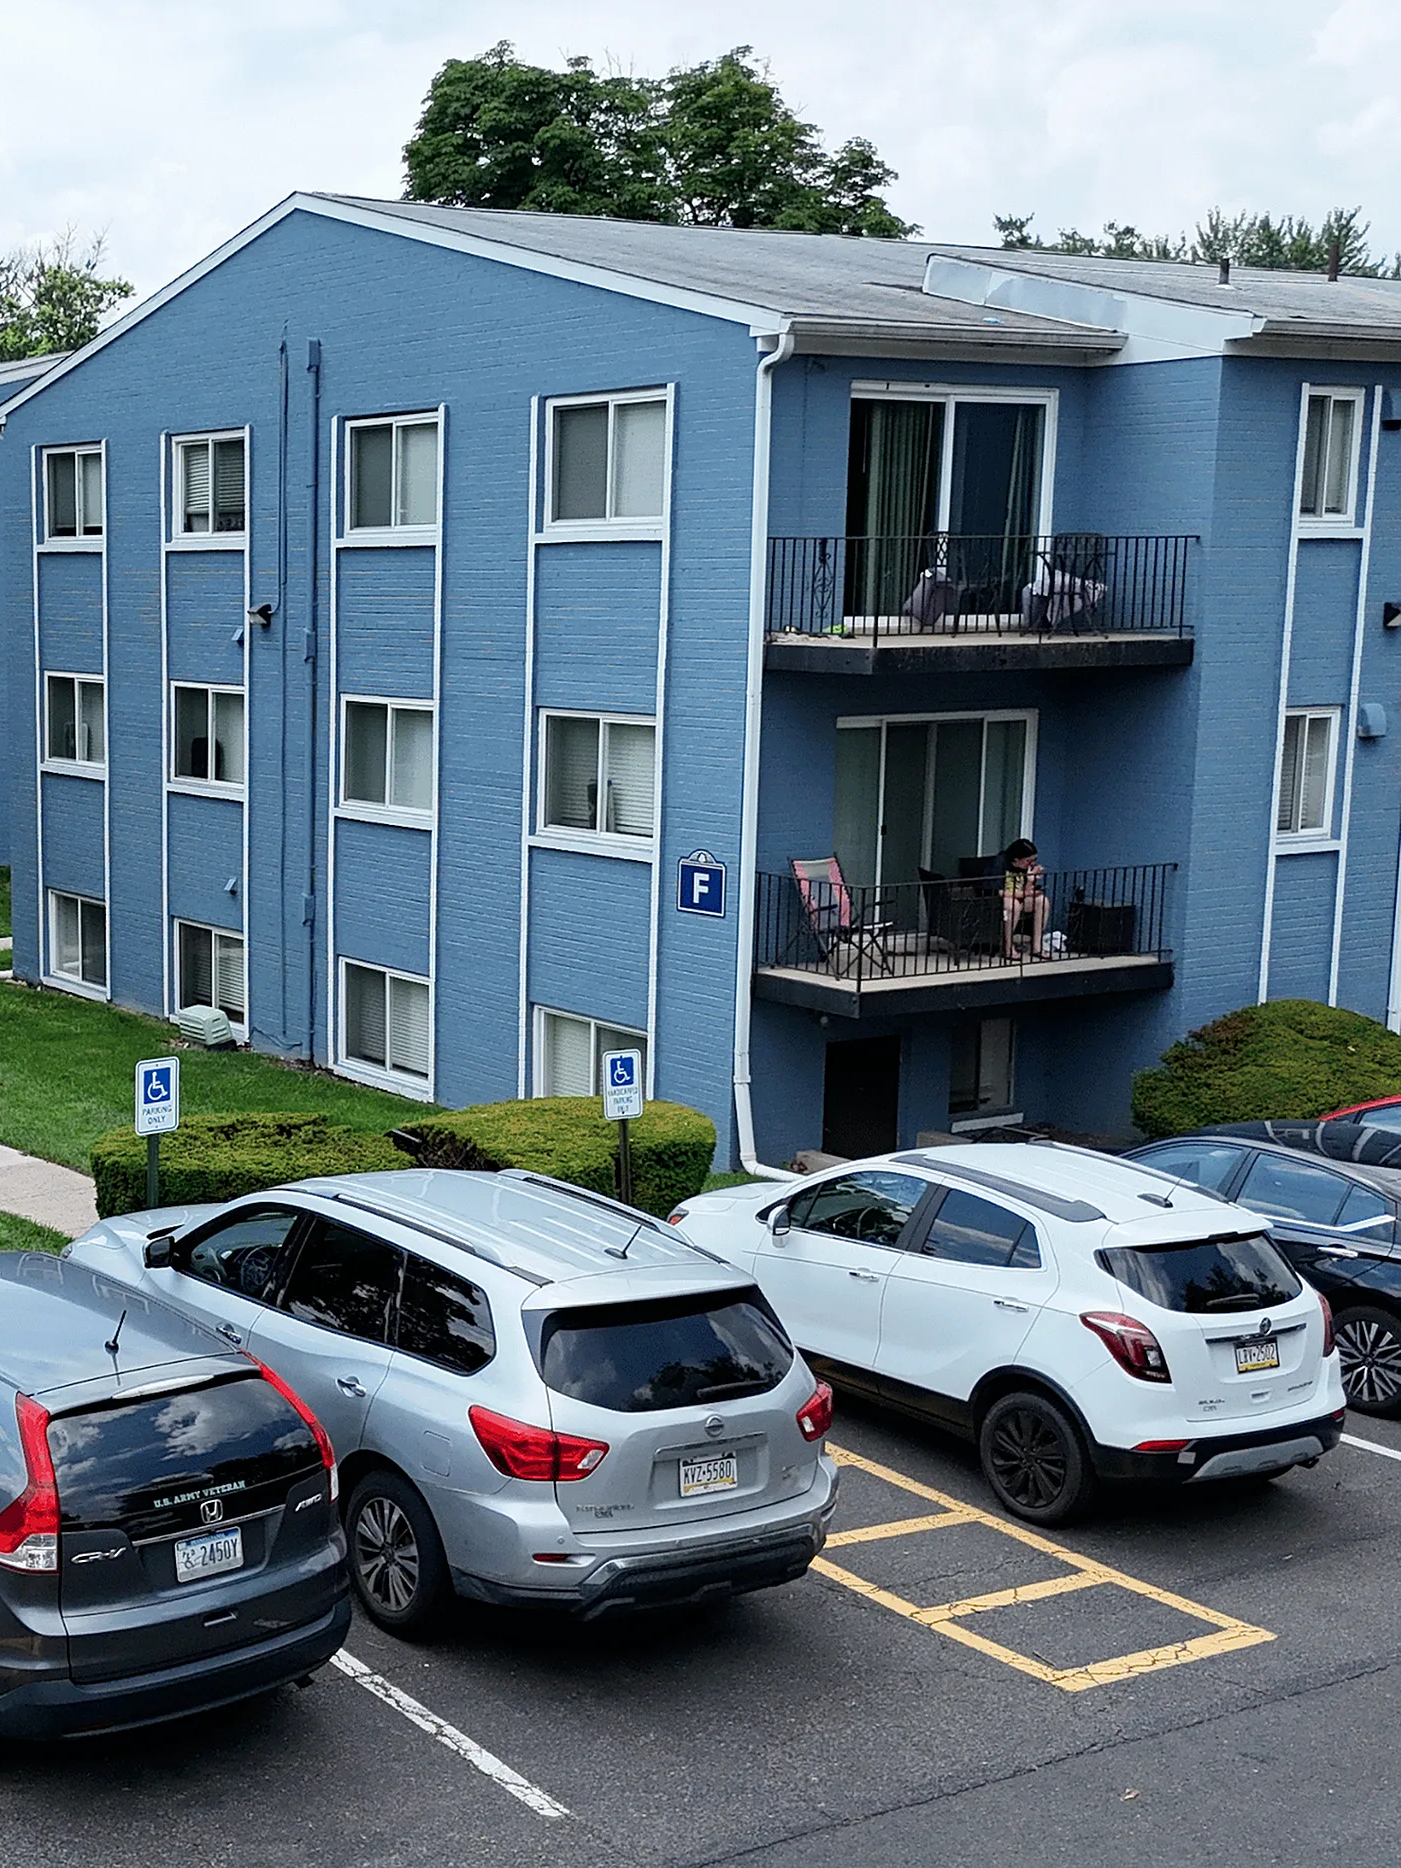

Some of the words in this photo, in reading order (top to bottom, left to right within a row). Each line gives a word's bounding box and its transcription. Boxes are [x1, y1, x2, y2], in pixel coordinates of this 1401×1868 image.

[693, 872, 710, 904] F
[142, 1104, 172, 1116] PARKING
[147, 1115, 166, 1125] ONLY
[153, 1498, 173, 1508] U.S.
[173, 1490, 201, 1504] ARMY
[202, 1480, 246, 1497] VETERAN
[200, 1538, 238, 1567] 2450Y
